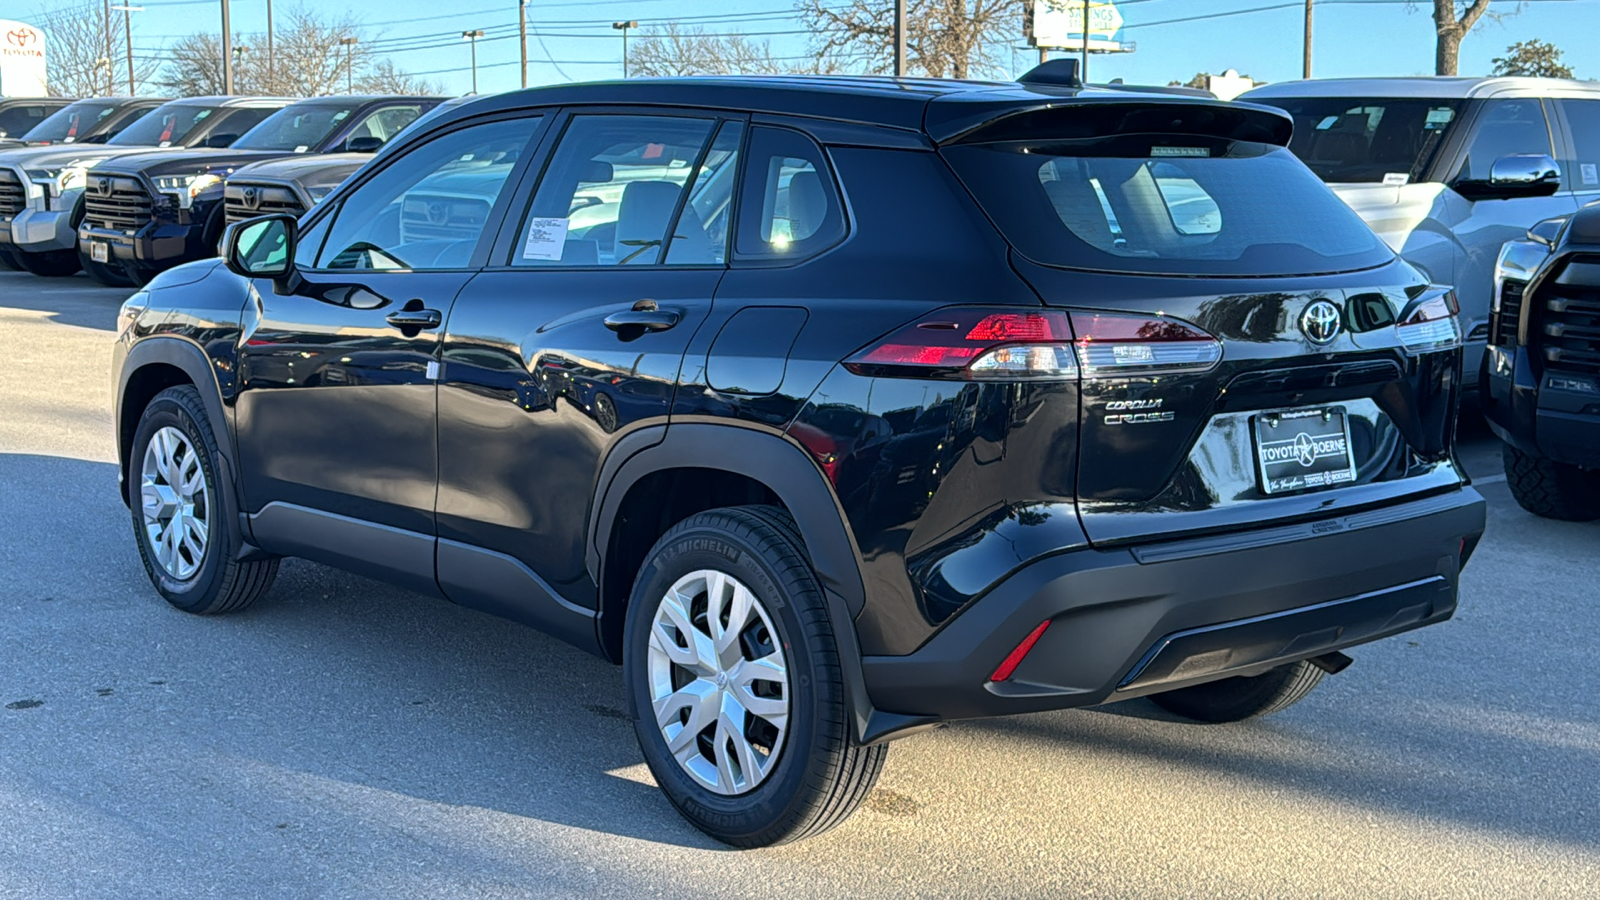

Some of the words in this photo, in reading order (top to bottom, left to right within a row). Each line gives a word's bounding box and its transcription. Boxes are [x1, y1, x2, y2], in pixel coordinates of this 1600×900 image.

[1068, 7, 1114, 21] SAINGS
[3, 48, 43, 57] TOYOTA
[1105, 398, 1163, 410] COROLLA
[1104, 411, 1175, 425] CROSS
[1262, 445, 1300, 460] TOYOTA
[1313, 438, 1346, 454] BOERNE
[1305, 475, 1324, 485] TOYOTA
[678, 538, 738, 560] MICHELIN
